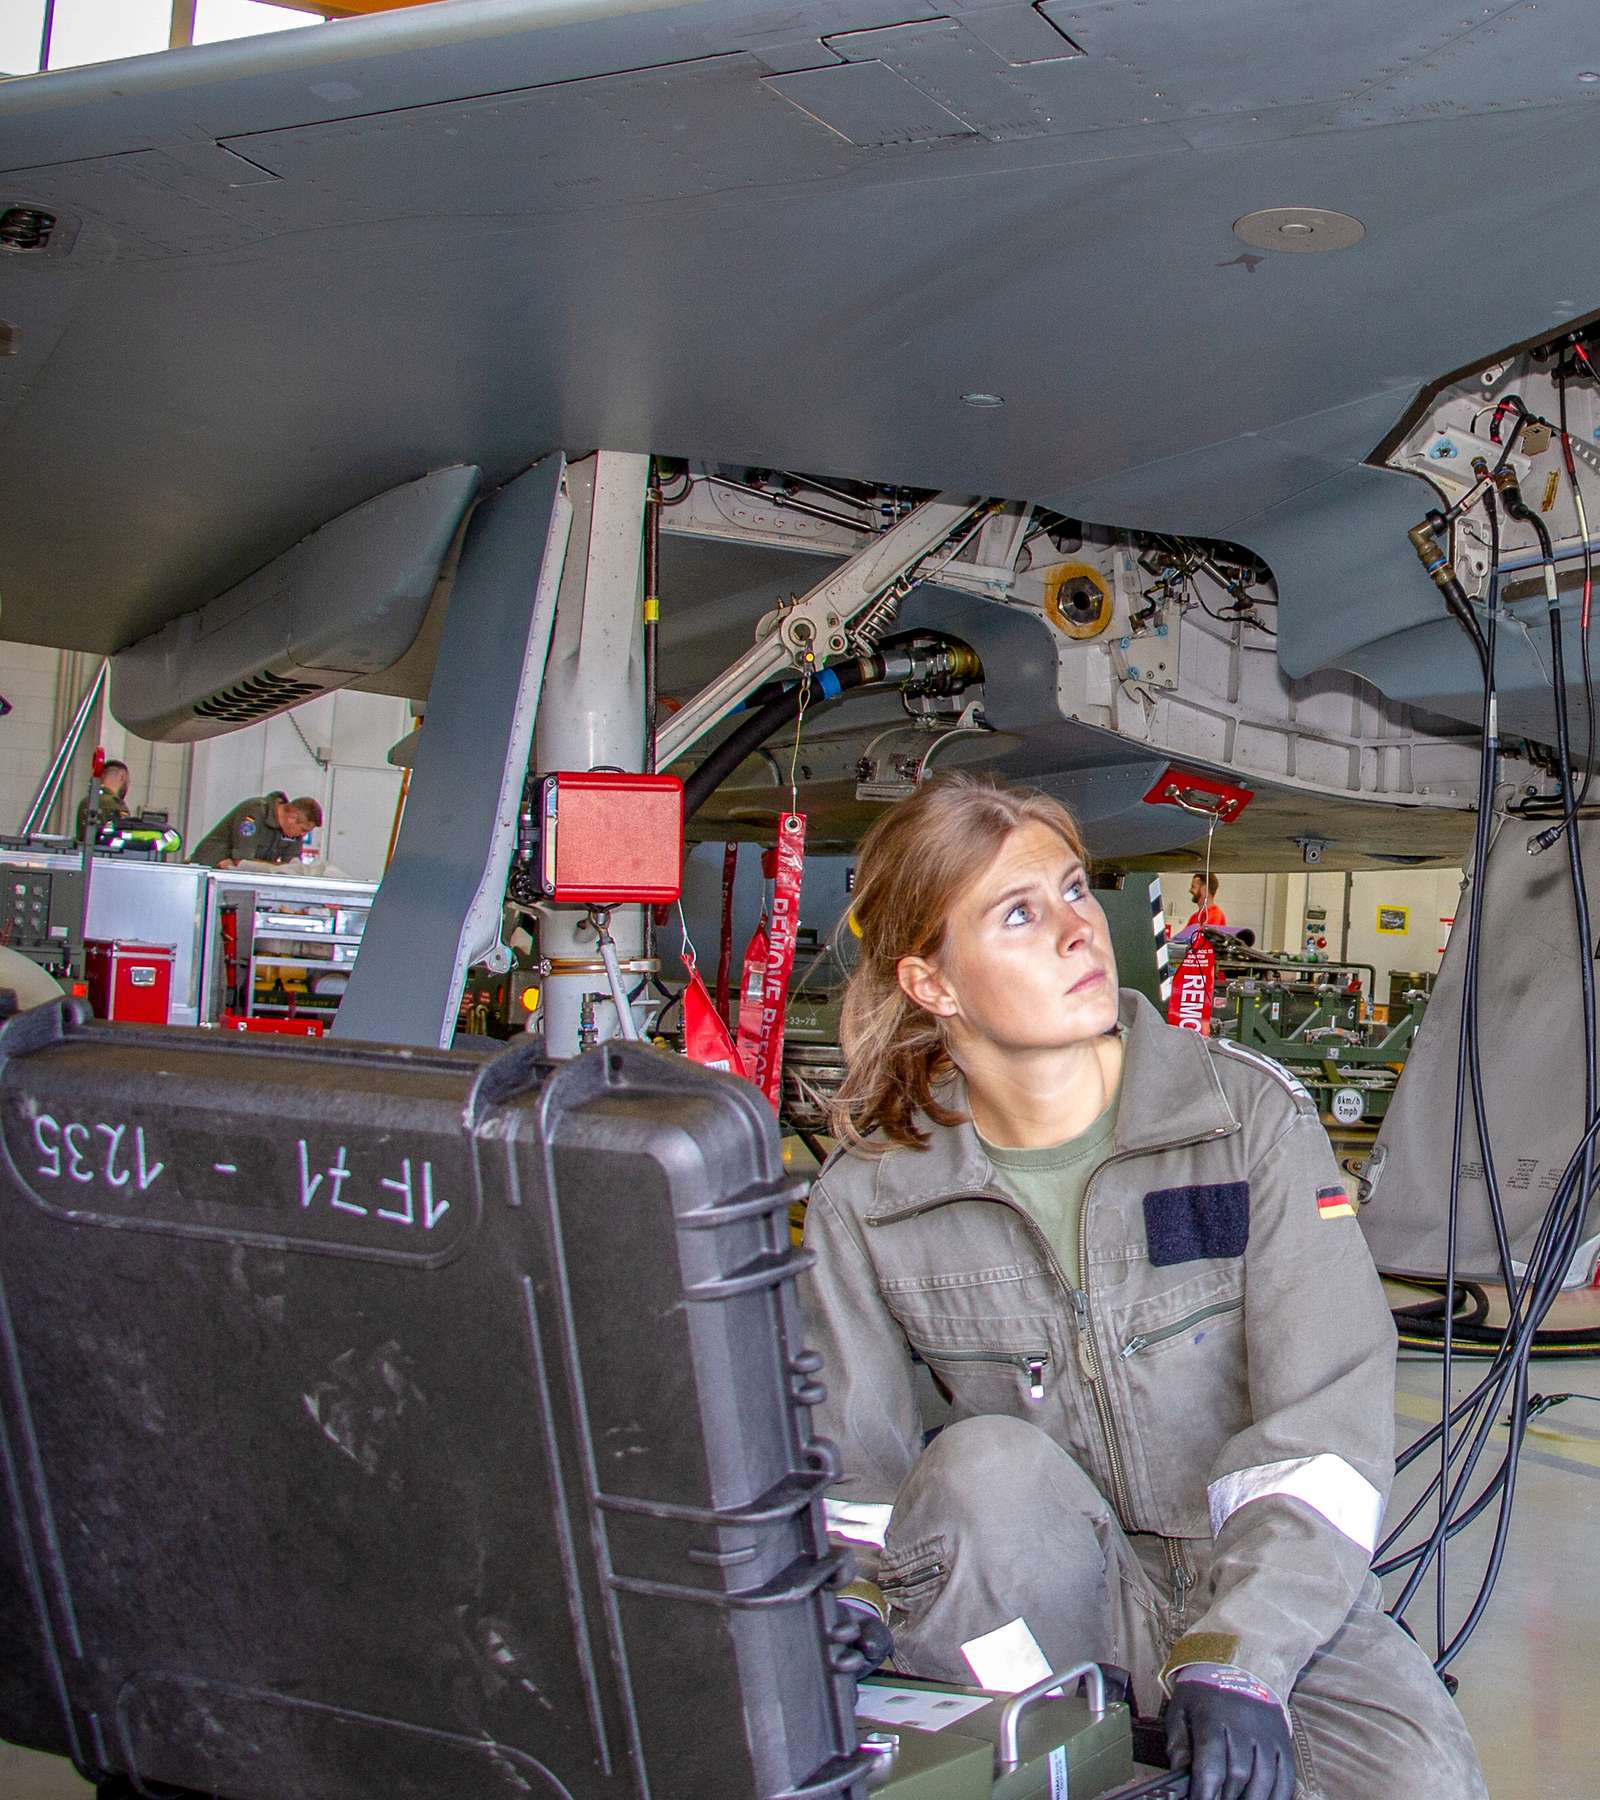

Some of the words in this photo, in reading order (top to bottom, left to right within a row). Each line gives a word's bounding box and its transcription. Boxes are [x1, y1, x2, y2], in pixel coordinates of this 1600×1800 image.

[1179, 974, 1206, 1034] REMO
[1338, 1107, 1358, 1117] 5mph
[34, 1114, 164, 1190] 1235
[299, 1139, 450, 1229] 1F71
